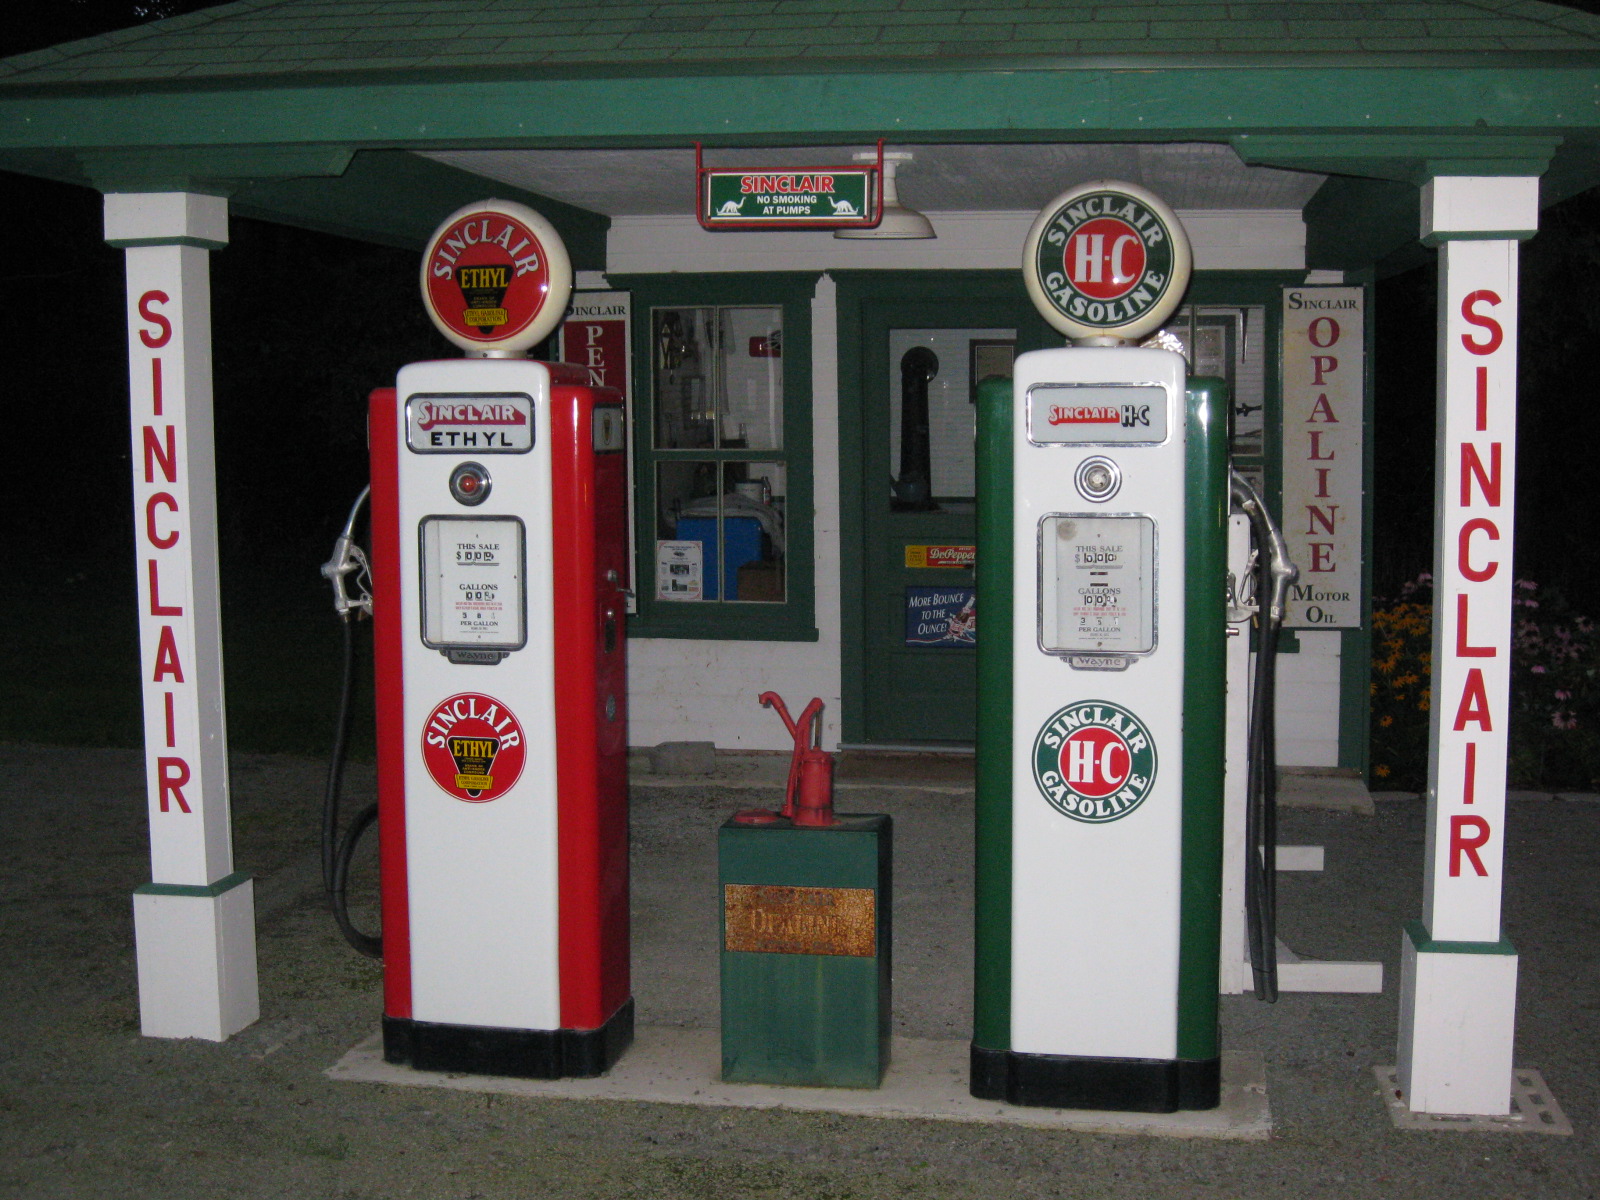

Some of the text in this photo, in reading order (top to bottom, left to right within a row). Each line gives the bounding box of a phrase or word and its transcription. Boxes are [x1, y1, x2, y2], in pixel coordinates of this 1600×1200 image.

[741, 176, 835, 193] SINCLAIR
[757, 195, 817, 204] NO SMOKING
[762, 206, 810, 215] AT PUMPS
[1047, 197, 1164, 248] SINCLAIR
[434, 219, 539, 280] SINCLAIR
[461, 267, 508, 289] ETHYL
[1046, 269, 1165, 322] GASOLINE
[1288, 291, 1358, 311] SINCLAIR
[418, 401, 520, 427] SINCLAIR
[1048, 404, 1120, 426] SINCLAIR
[430, 431, 513, 447] ETHYL
[1305, 316, 1340, 573] OPALINE
[138, 289, 192, 814] SINCLAIR
[459, 583, 498, 591] GALLONS
[1077, 587, 1121, 595] GALLONS
[1292, 584, 1350, 602] MOTOR
[1448, 289, 1504, 877] SINCLAIR
[909, 593, 964, 608] MORE BOUNCE
[922, 609, 946, 620] TO THE
[1305, 605, 1337, 624] OIL
[917, 622, 947, 635] OUNCE!
[427, 698, 520, 751] SINCLAIR
[1044, 706, 1147, 754] SINCLAIR
[453, 739, 495, 758] ETHYL
[1042, 770, 1148, 817] GASOLINE
